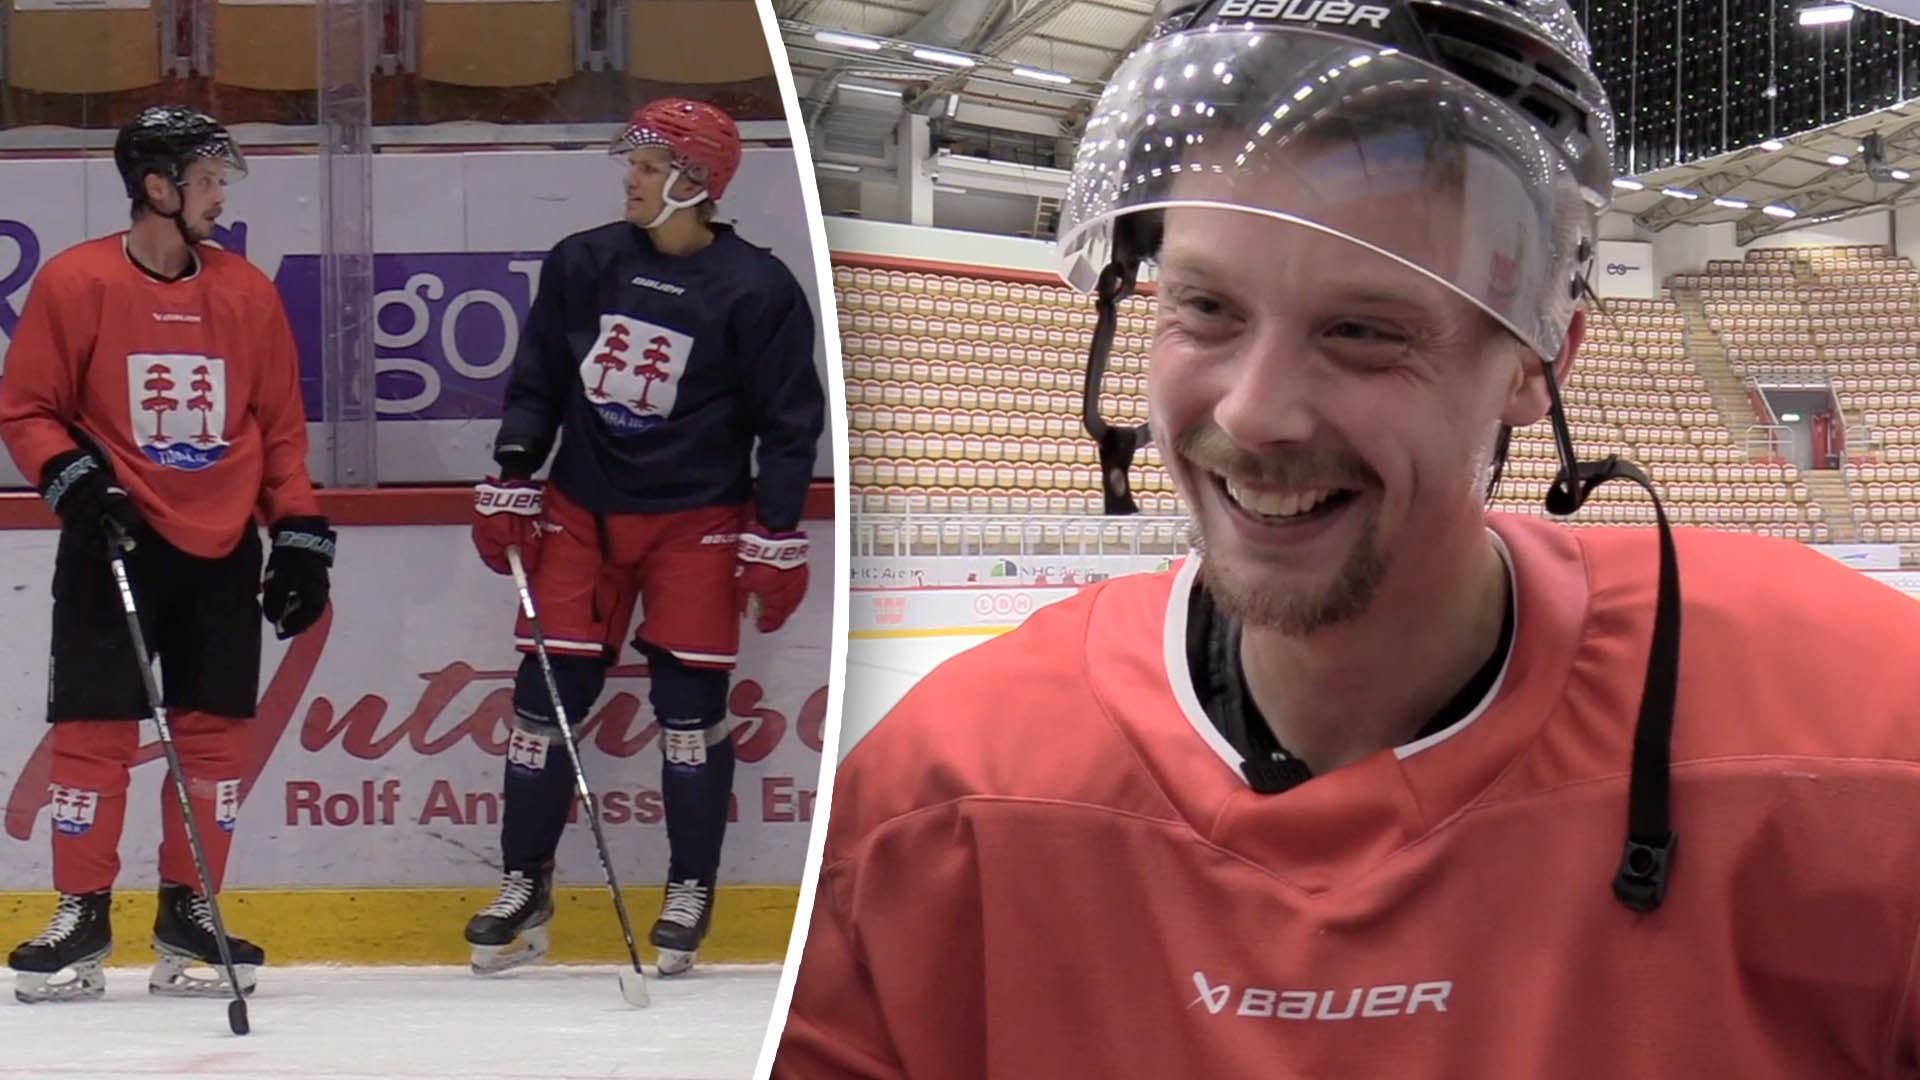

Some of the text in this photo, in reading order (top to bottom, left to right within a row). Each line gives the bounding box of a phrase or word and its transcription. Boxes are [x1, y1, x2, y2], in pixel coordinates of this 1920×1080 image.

[1217, 0, 1391, 28] BAUER
[286, 780, 400, 826] Rolf
[1235, 980, 1454, 1021] BAUER
